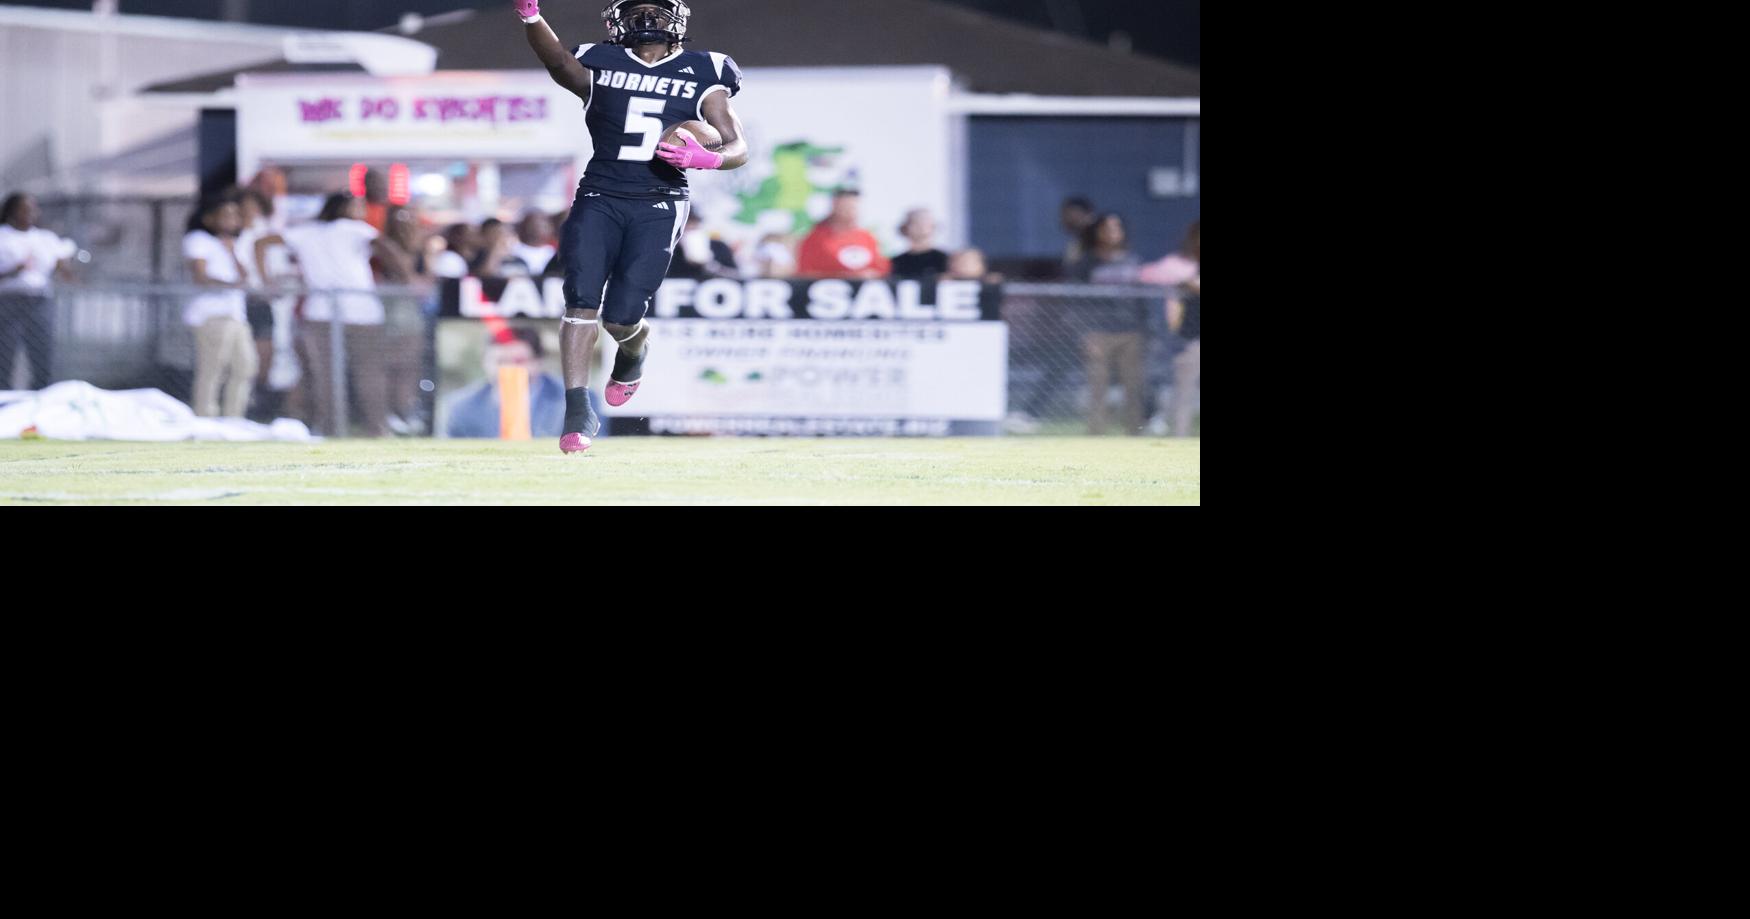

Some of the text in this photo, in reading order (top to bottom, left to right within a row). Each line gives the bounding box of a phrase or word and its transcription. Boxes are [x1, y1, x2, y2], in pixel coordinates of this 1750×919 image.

[596, 69, 698, 98] HORNETS
[617, 96, 667, 161] 5
[459, 277, 983, 319] LA FOR SALE
